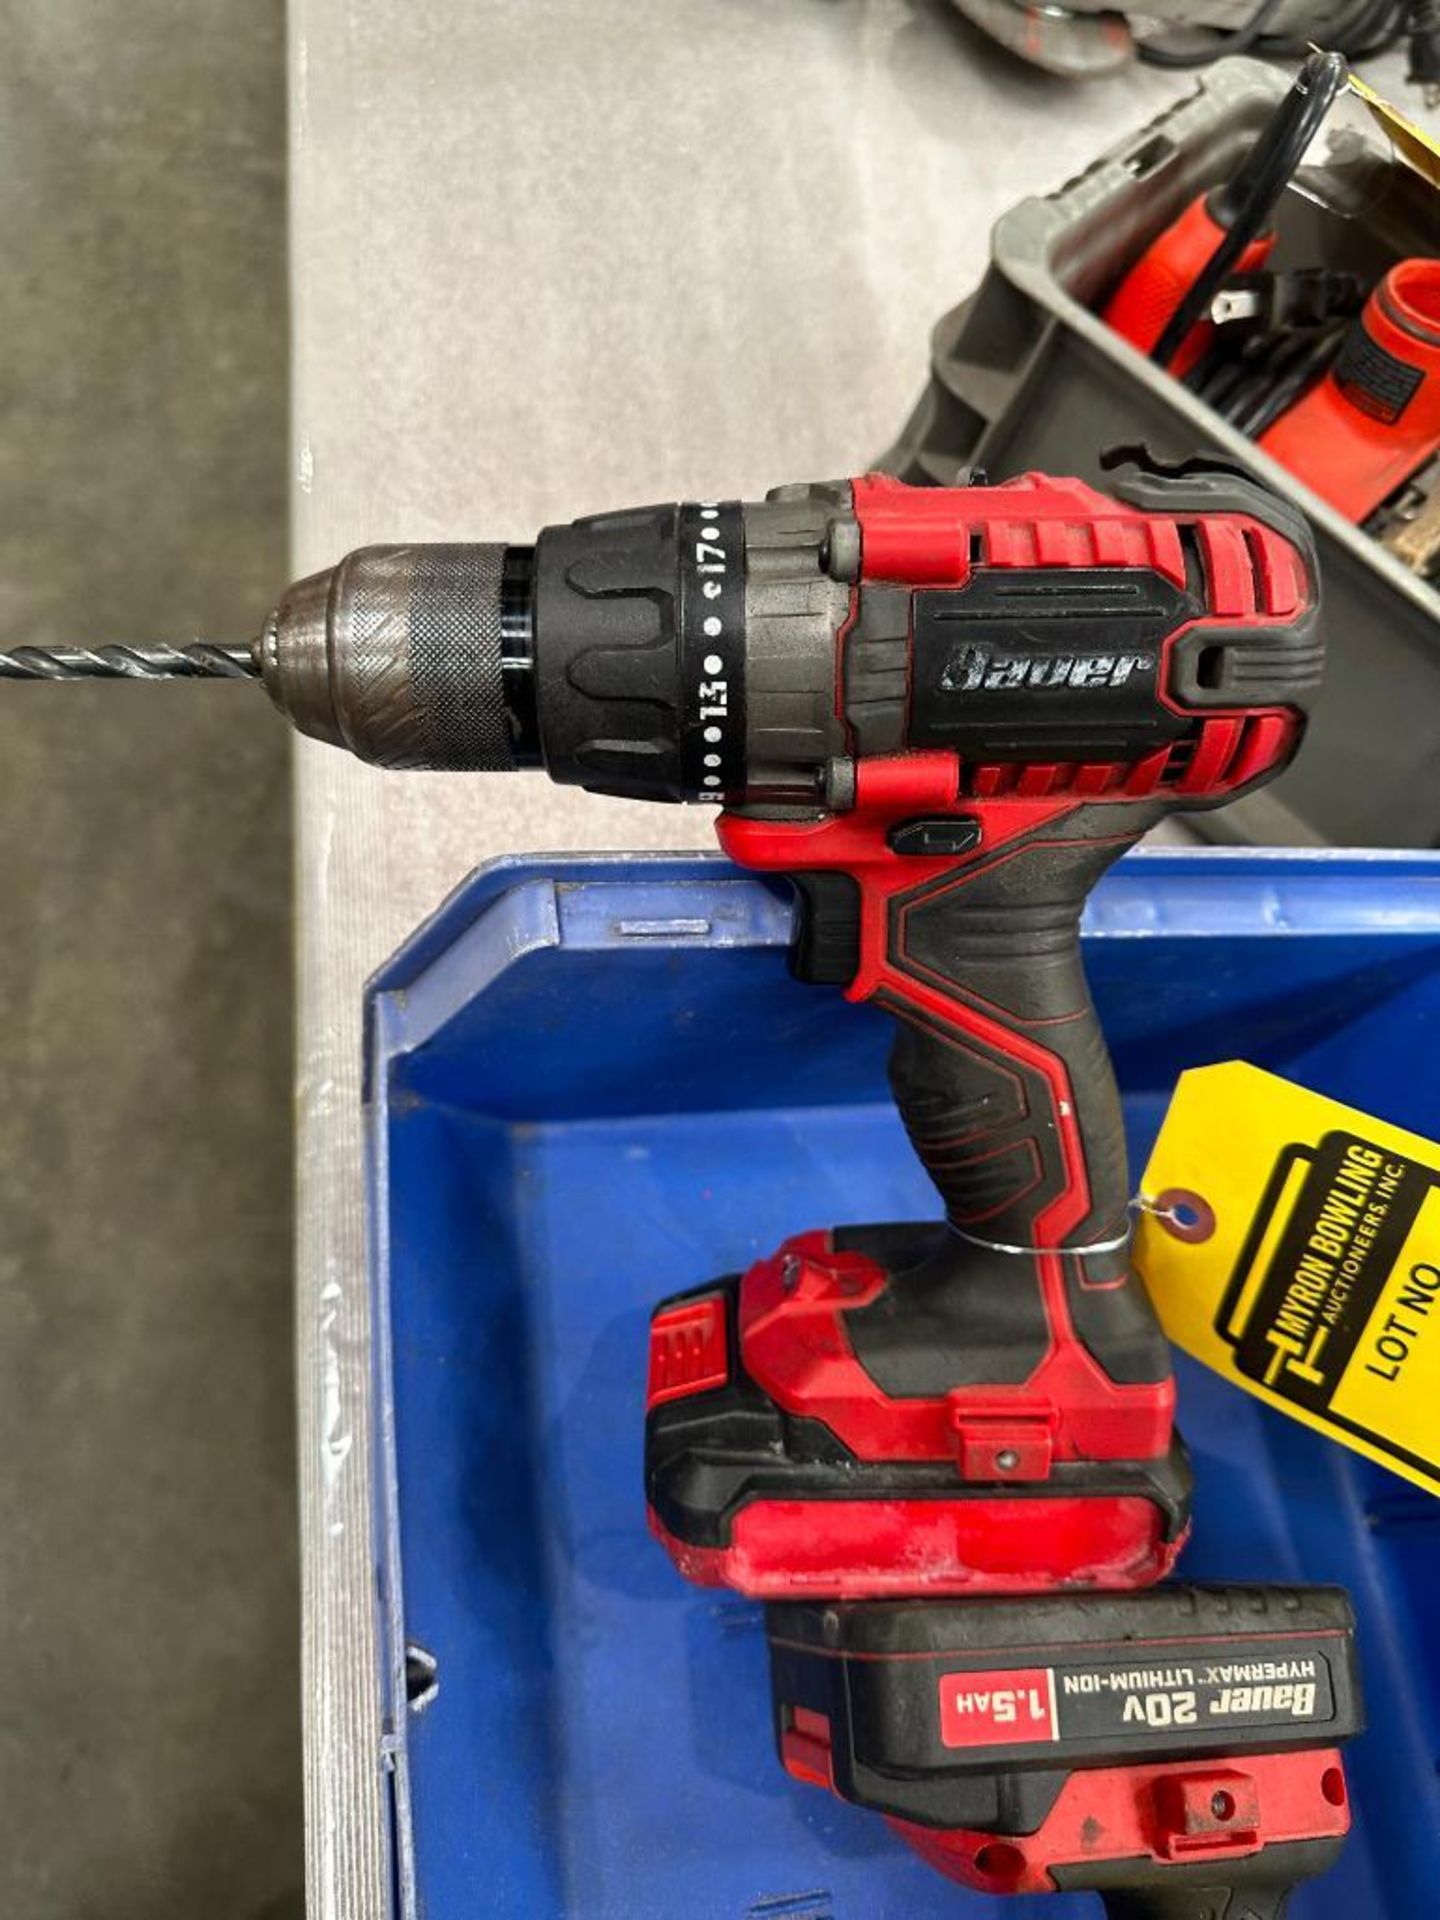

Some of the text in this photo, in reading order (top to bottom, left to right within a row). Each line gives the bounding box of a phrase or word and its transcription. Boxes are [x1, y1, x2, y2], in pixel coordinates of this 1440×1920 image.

[696, 543, 726, 574] 17
[938, 643, 1155, 691] Bauer
[698, 681, 728, 720] 13
[1275, 1145, 1384, 1338] MYRON BOWLING
[1321, 1163, 1407, 1324] AUCTIONEERS, INC.
[1365, 1262, 1440, 1382] LOT NO
[1063, 1668, 1194, 1694] LITHIUM-ION
[1209, 1683, 1316, 1716] Bauer
